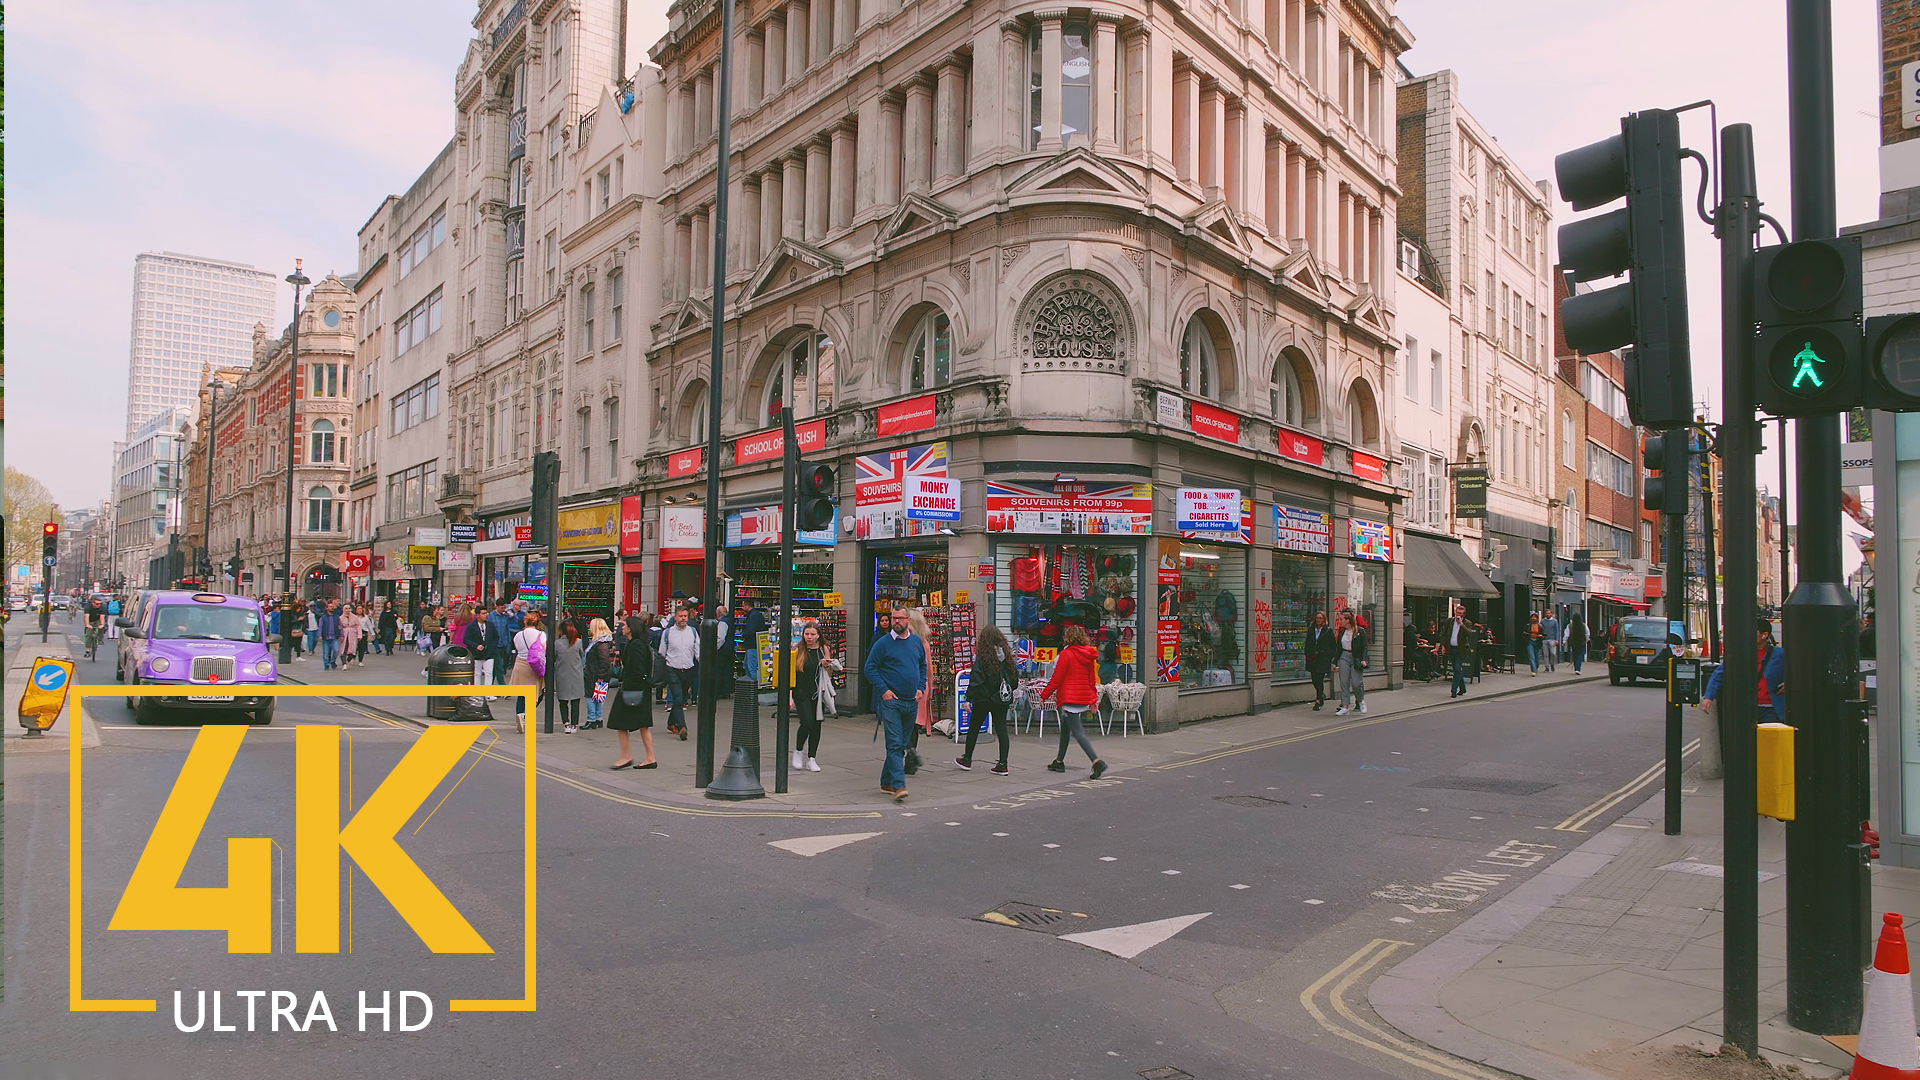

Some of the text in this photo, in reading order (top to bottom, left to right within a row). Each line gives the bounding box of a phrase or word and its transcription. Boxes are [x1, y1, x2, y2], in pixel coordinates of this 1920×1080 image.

[1033, 291, 1115, 336] BERWICK
[1059, 324, 1094, 337] 1886
[1047, 338, 1107, 358] HOUSE
[1159, 395, 1179, 408] BERWICK
[1159, 405, 1175, 416] STREET
[1195, 414, 1235, 432] SCHOOL OF ENGLISH
[744, 441, 772, 456] SCHOOL
[772, 437, 784, 450] OF
[1842, 458, 1873, 468] SSOPS
[862, 482, 902, 497] SOUVENIRS
[920, 480, 949, 494] MONEY
[1053, 485, 1086, 493] ALL IN ONE
[1184, 491, 1202, 499] FOOD
[912, 495, 956, 510] EXCHANGE
[1010, 497, 1123, 508] SOUVENIRS FROM 99p
[1189, 512, 1230, 521] CIGARETTES
[677, 523, 693, 531] Ben's
[678, 529, 699, 537] Cookies
[931, 592, 941, 605] £1
[1036, 649, 1053, 661] £1
[1427, 839, 1557, 901] LOOK LEFT
